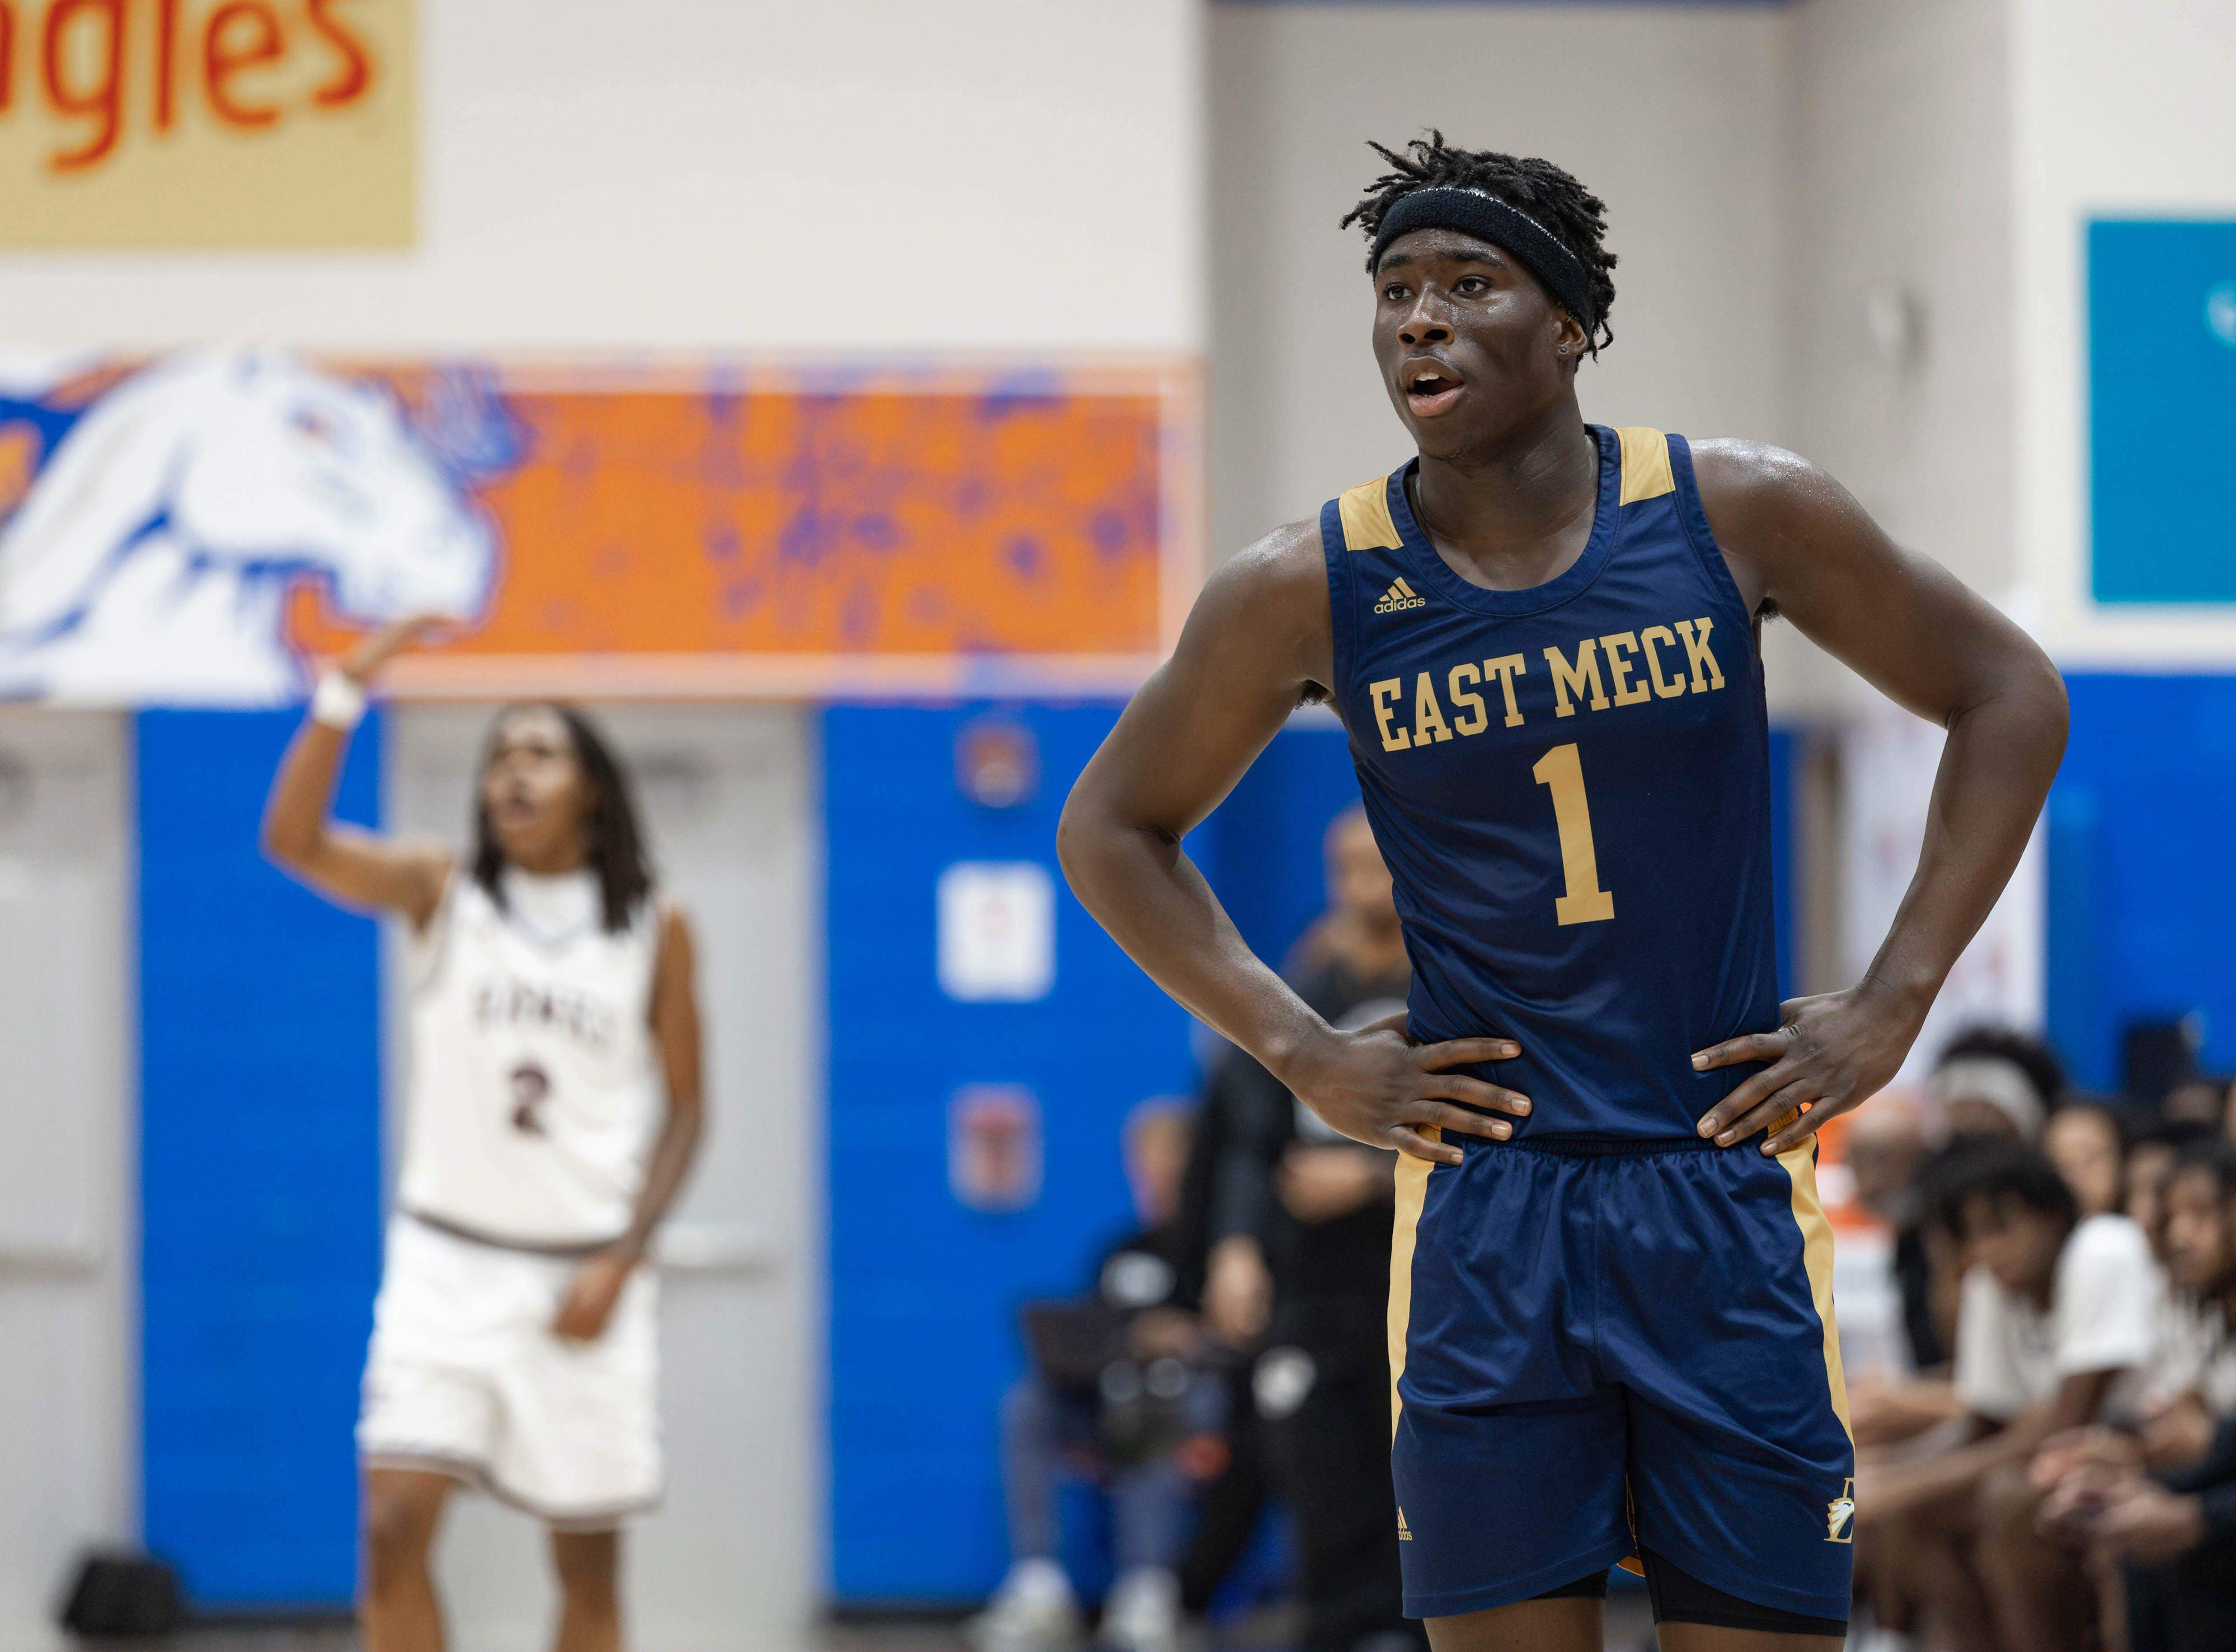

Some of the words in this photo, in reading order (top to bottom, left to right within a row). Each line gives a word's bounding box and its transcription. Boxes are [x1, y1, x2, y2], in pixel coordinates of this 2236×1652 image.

[1374, 597, 1426, 614] adidas
[1369, 653, 1527, 753] EAST
[1543, 616, 1726, 719] MECK
[1532, 742, 1615, 927] 1
[509, 1063, 549, 1138] 2
